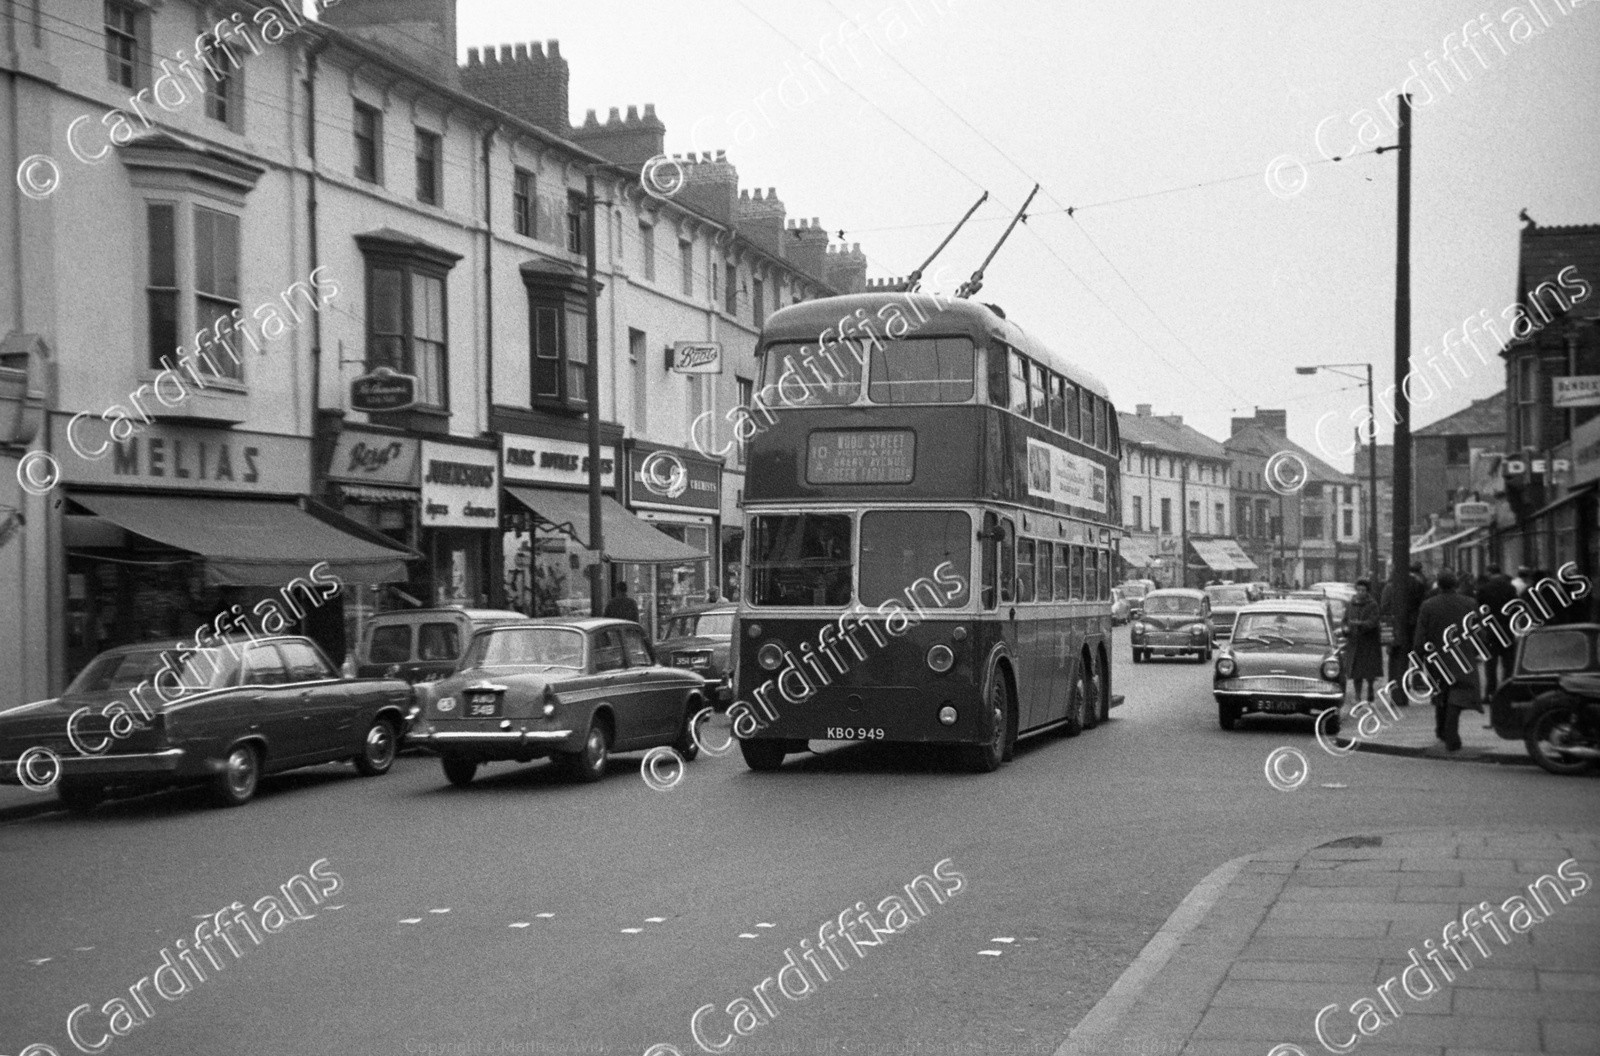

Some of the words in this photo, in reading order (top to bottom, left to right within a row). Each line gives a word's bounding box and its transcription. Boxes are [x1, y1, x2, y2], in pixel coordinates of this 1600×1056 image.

[869, 434, 905, 449] STREET
[811, 446, 828, 459] 10
[113, 438, 259, 483] MELIAS
[1507, 459, 1571, 474] DER
[827, 727, 855, 739] KBO
[857, 728, 885, 740] 949
